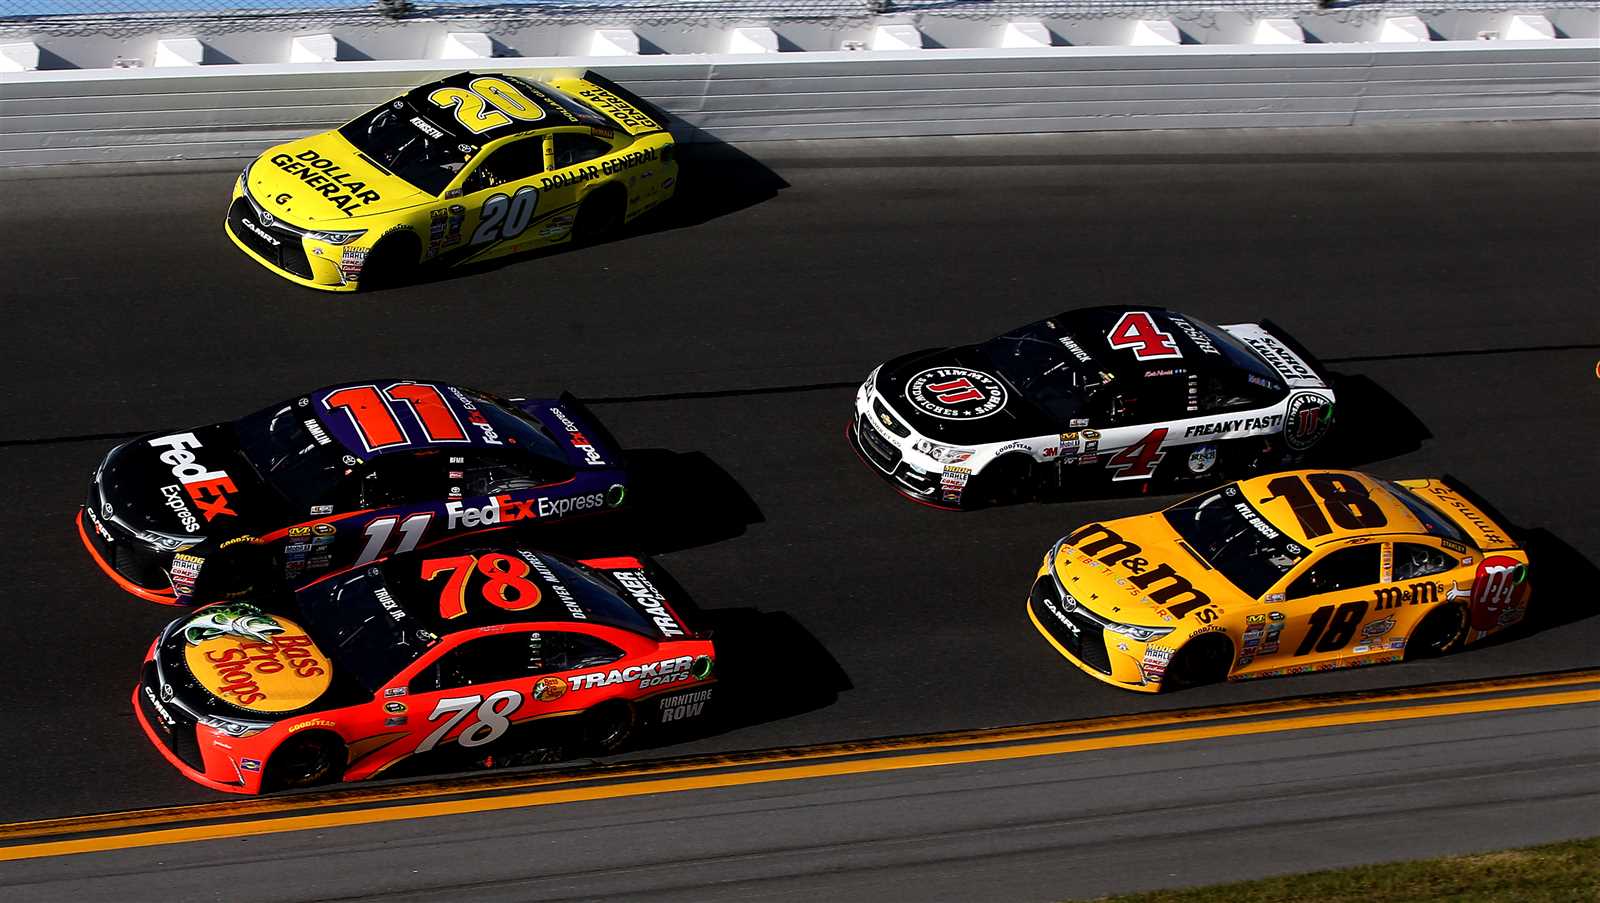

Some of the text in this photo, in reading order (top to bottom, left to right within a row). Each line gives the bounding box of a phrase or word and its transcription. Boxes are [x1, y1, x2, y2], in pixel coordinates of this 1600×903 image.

[428, 77, 545, 135] 20
[580, 90, 638, 128] DOLLAR
[592, 85, 656, 129] GENERAL
[410, 116, 444, 139] KENSETH
[271, 153, 362, 218] GENERAL
[296, 150, 381, 206] DOLLAR
[541, 147, 657, 193] DOLLAR GENERAL
[242, 218, 281, 246] CAMRY
[470, 186, 539, 245] 20
[1059, 336, 1092, 363] HARVICK
[1107, 311, 1183, 361] 4
[937, 369, 992, 384] JIMMY
[321, 382, 471, 452] 11
[975, 385, 1001, 415] JOHN'S
[304, 418, 332, 446] HAMLIN
[467, 409, 504, 446] FedEx
[1184, 414, 1283, 438] FREAKY FAST!
[570, 431, 607, 466] FedEx
[995, 441, 1032, 456] GOODYEAR
[1043, 447, 1058, 457] 3M
[1105, 428, 1169, 481] 4
[148, 432, 239, 523] FedEx
[87, 507, 114, 542] CAMRY
[160, 483, 200, 533] Express
[445, 492, 604, 530] FedEx Express
[1235, 502, 1279, 540] KYLE BUSCH
[1260, 473, 1388, 540] 18
[219, 533, 265, 550] GOODYEAR
[353, 511, 435, 567] 11
[174, 553, 205, 564] MOOG
[374, 587, 406, 622] TRUEX JR.
[421, 552, 542, 620] 78
[552, 585, 588, 620] DENVER
[613, 570, 685, 637] TRACKER
[1043, 598, 1082, 637] CAMRY
[1293, 600, 1369, 657] 18
[240, 640, 284, 675] Pro
[273, 634, 325, 679] Bass
[568, 656, 693, 691] TRACKER
[204, 648, 267, 706] Shops
[639, 671, 690, 689] BOATS
[145, 686, 176, 725] CAMRY
[659, 688, 713, 710] FURNITURE
[662, 701, 705, 723] ROW
[288, 717, 336, 734] GOODYEAR
[414, 690, 523, 754] 78
